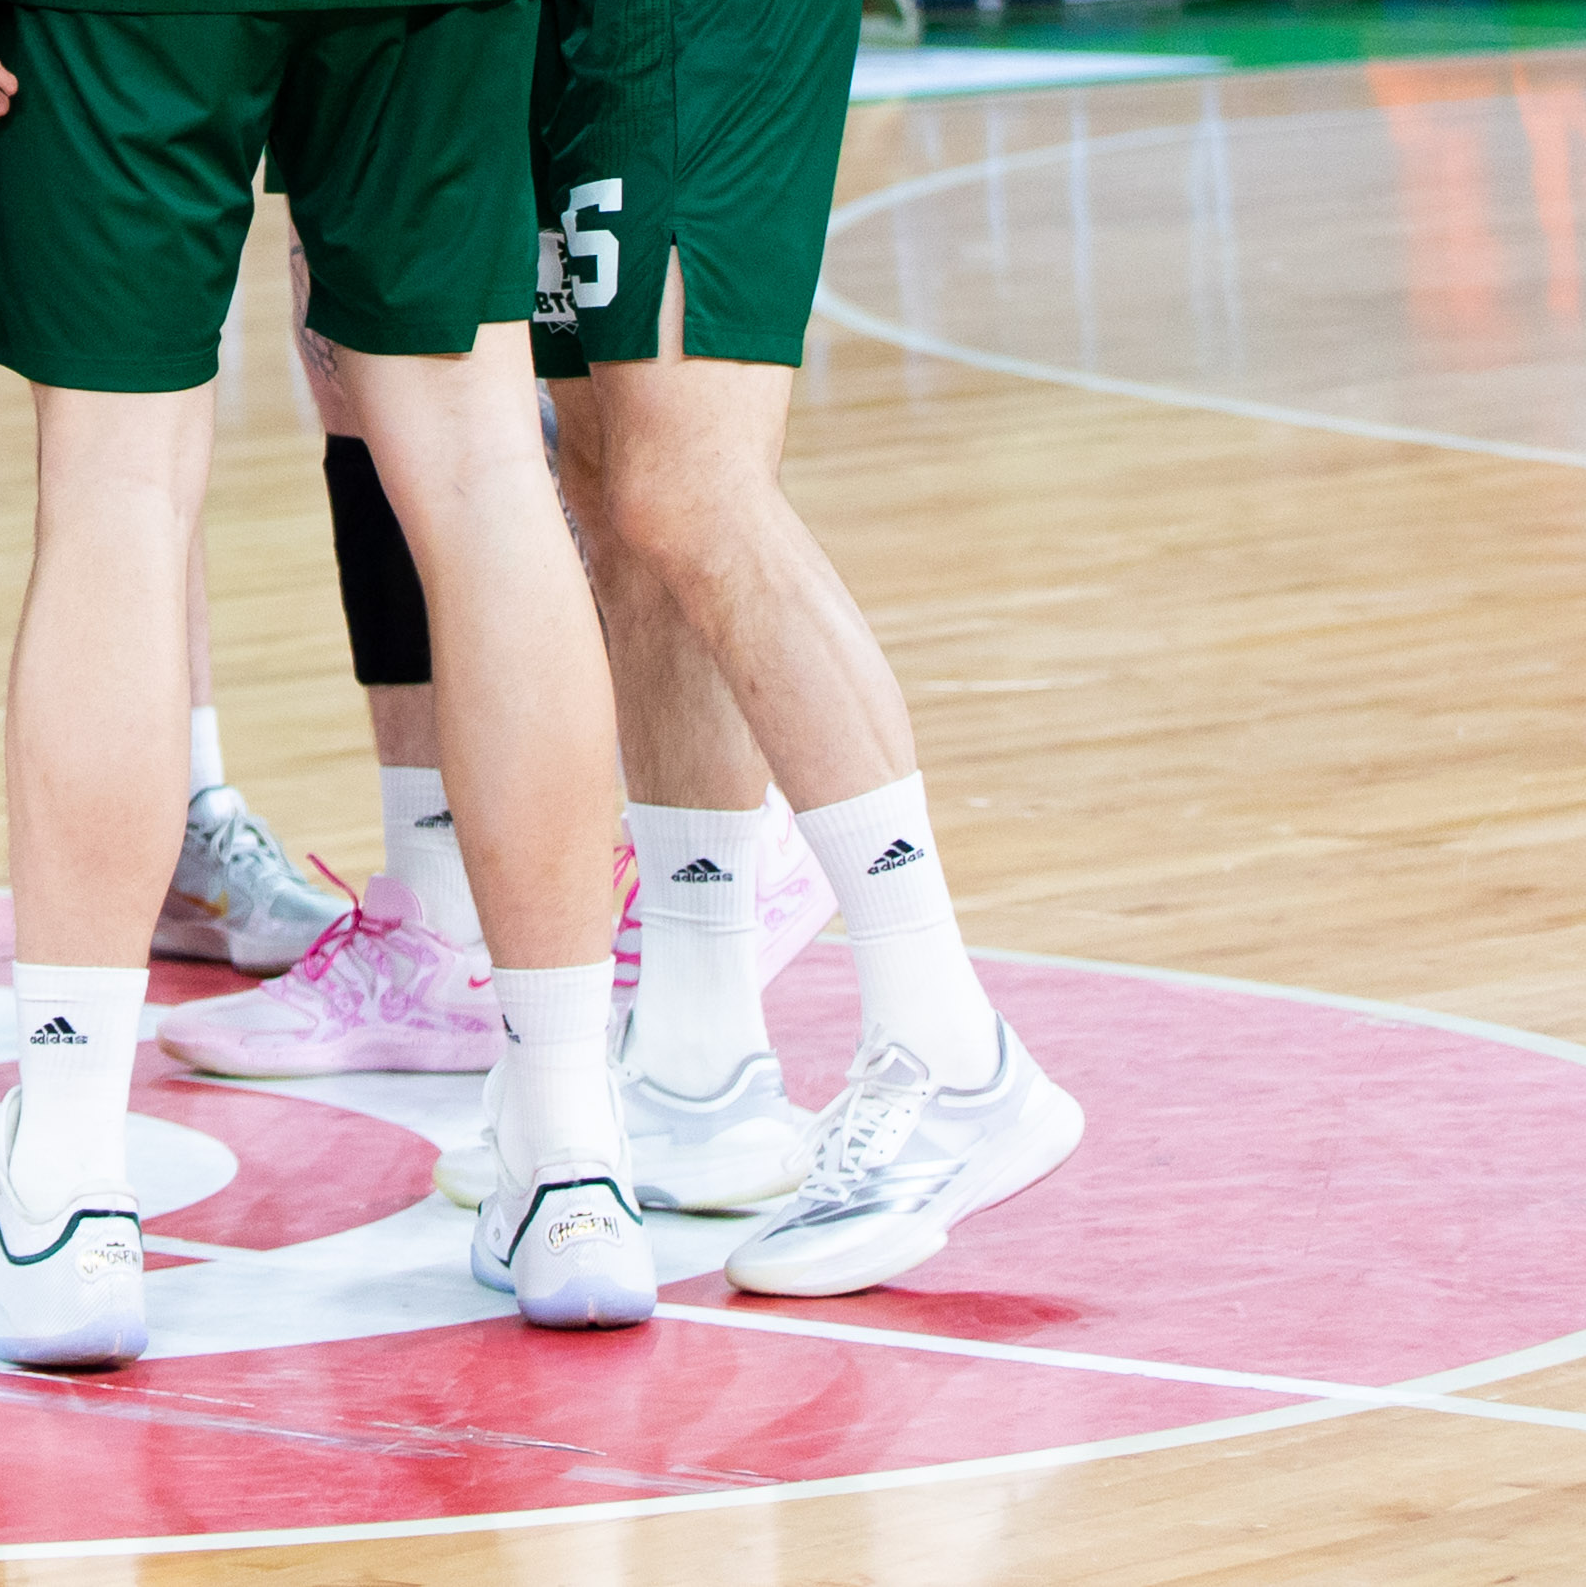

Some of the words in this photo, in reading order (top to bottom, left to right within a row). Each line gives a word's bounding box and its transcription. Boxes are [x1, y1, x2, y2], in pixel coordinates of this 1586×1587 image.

[867, 847, 925, 876] adidas
[671, 869, 733, 883] adidas
[29, 1033, 89, 1045] adidas
